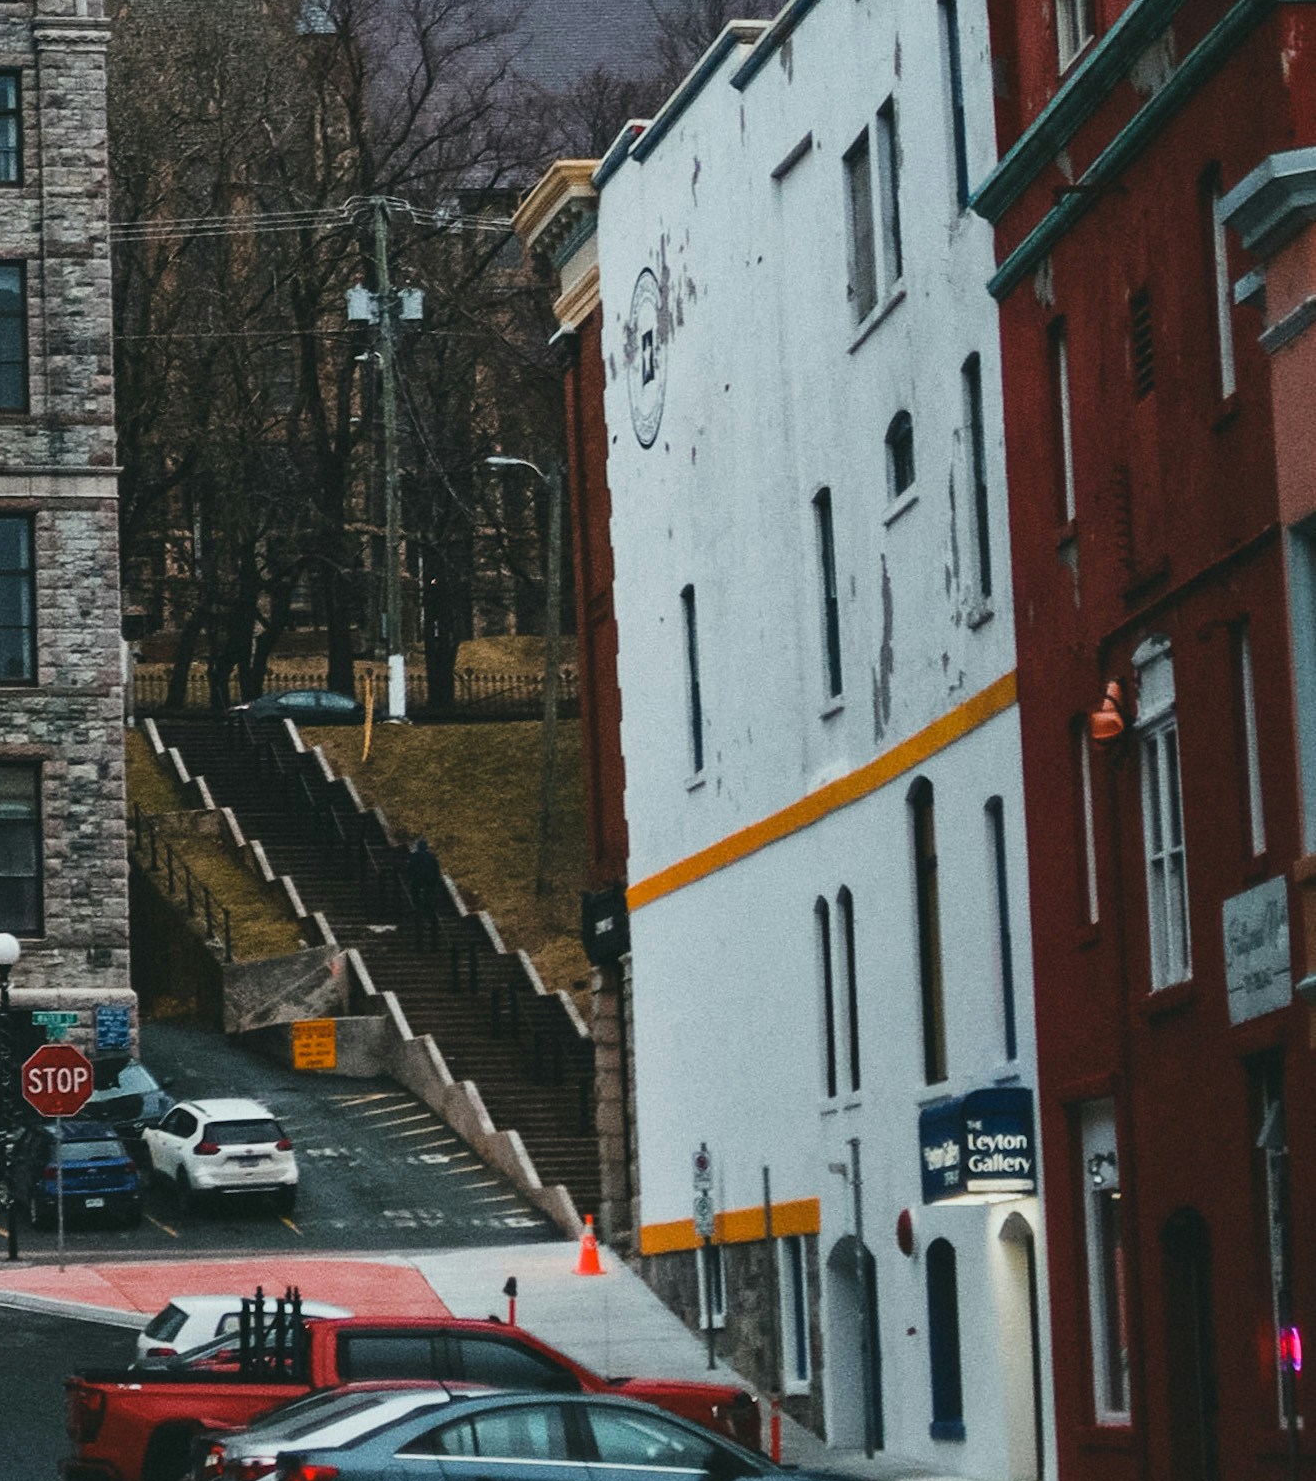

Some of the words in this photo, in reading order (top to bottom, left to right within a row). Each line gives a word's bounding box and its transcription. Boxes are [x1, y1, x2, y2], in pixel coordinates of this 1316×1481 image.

[28, 1067, 89, 1094] STOP
[967, 1133, 1028, 1153] Leyton
[968, 1153, 1032, 1174] Gallery
